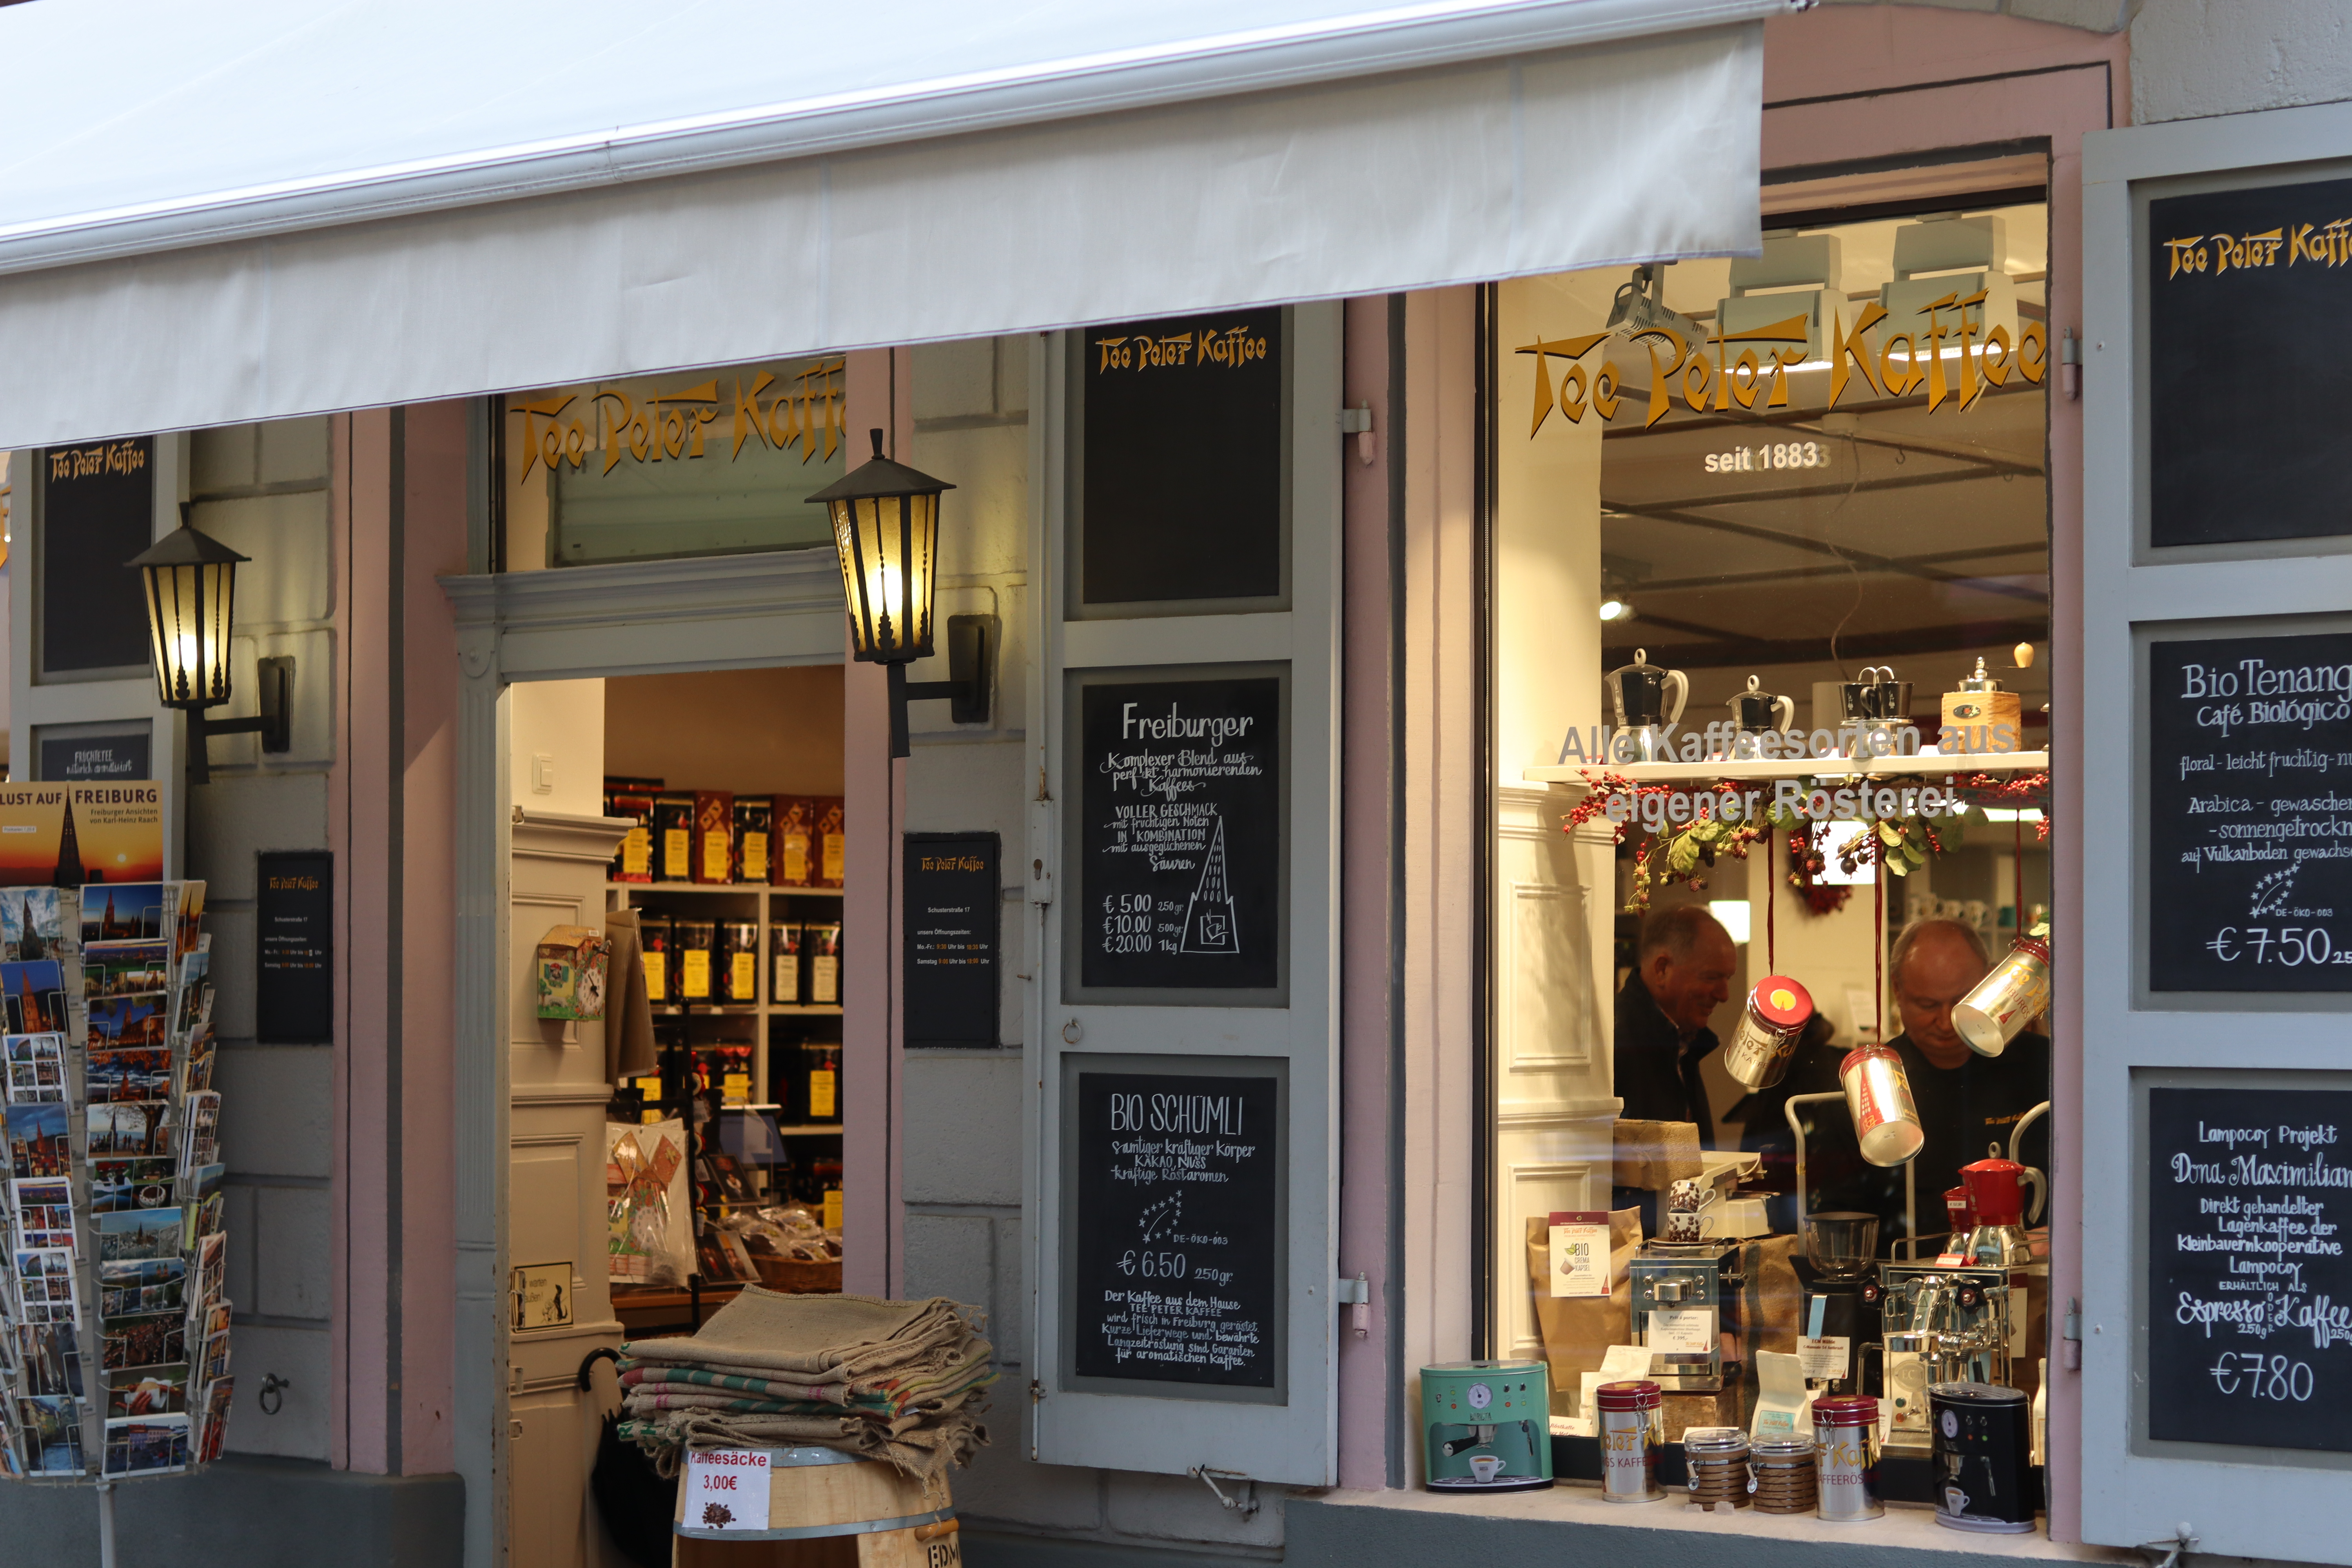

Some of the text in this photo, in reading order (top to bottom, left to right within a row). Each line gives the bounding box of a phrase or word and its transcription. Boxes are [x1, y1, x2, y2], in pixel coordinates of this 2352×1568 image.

[2163, 218, 2352, 281] Tee Peter Kaff
[1095, 325, 1267, 375] Tee Peter Kaffee
[1515, 288, 2046, 440] Tee Peter Kaffee
[510, 360, 846, 486] Tee Peter Kaff
[50, 440, 145, 483] Tee Peter Kaffee
[1704, 441, 1819, 473] seit 1883
[2181, 664, 2238, 699] Bio
[1123, 702, 1253, 747] Freiburger
[2197, 699, 2351, 737] Café Biológico
[1558, 720, 2015, 764] Alle Kaffeesorten aus
[1100, 747, 1254, 773] Komplexer Blend aus
[2180, 751, 2267, 781] floral leicht
[1113, 763, 1262, 791] perfekt harmonierenden
[1141, 775, 1206, 801] Kaffees
[0, 789, 157, 805] LUST AUF FREIBURG
[1606, 777, 1955, 833] eigener Rösterei
[2187, 794, 2254, 813] Arabica
[91, 808, 124, 816] Freiburger
[1115, 802, 1218, 819] VOLLER GESCHMACK
[1103, 815, 1209, 835] mit fruchtigen Noten
[1117, 828, 1206, 843] IN KOMBINATION
[1102, 840, 1206, 857] mit ausgeglichenen
[2181, 841, 2288, 873] auf Vulkanboden
[920, 856, 984, 873] Tee Peter Kaffee
[1149, 855, 1196, 872] Säuren
[1111, 1093, 1243, 1135] BIO SCHÜMLI
[2199, 1120, 2337, 1152] Lampocoy Projekt
[1165, 1138, 1214, 1161] kräftiger
[1111, 1164, 1229, 1186] kräftige Röstaromen
[2171, 1152, 2225, 1184] Dona
[2200, 1195, 2324, 1221] Direkt gehandelter
[2219, 1216, 2337, 1243] Lagenkaffee der
[1575, 1243, 1589, 1256] BIO
[2178, 1234, 2343, 1262] Kleinbauernkooperative
[2230, 1255, 2303, 1286] Lampocoy
[2219, 1279, 2307, 1293] ERHÄLTLICH ALS
[1105, 1290, 1241, 1310] Der Kaffee aus dem Hause
[1129, 1303, 1222, 1317] TEE PETER KAFFEE
[1107, 1311, 1129, 1323] wird
[1131, 1313, 1158, 1331] frisch
[1161, 1316, 1171, 1325] in
[1172, 1316, 1216, 1332] Freiburg
[2177, 1292, 2267, 1338] Espresso
[2275, 1294, 2352, 1348] Kaffee
[2237, 1323, 2267, 1339] 250g
[1102, 1323, 1259, 1344] Kurze Lieferwege und bewährte
[1107, 1335, 1256, 1357] Langzeitröstung sind Garanten
[1115, 1347, 1132, 1363] für
[1136, 1350, 1207, 1363] aromatischen
[691, 1451, 767, 1466] Kaffeesäcke
[703, 1475, 737, 1492] 3,00€
